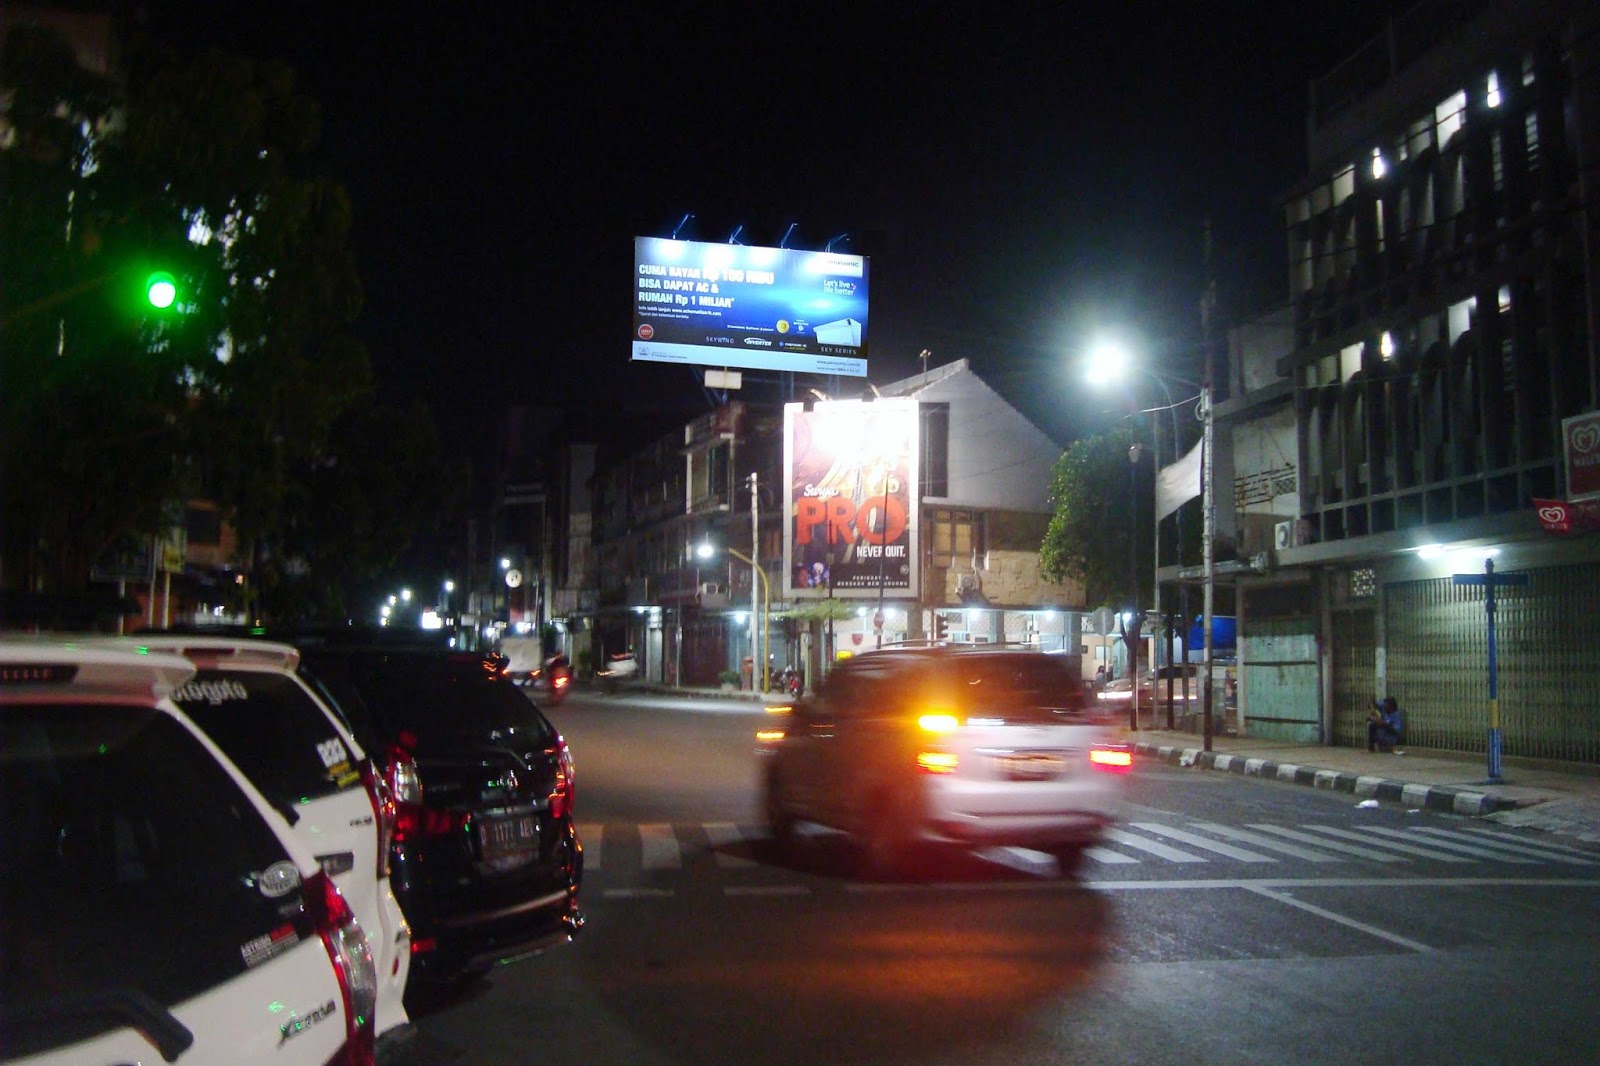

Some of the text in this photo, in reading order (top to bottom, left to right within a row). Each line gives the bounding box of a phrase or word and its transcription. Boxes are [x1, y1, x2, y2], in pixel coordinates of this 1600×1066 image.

[639, 264, 667, 276] CUMA
[639, 278, 661, 289] BISA
[664, 280, 694, 292] DAPAT
[695, 282, 709, 293] AC
[639, 292, 673, 304] RUMAH
[675, 294, 688, 306] Rp
[691, 295, 696, 305] 1
[796, 496, 907, 546] PRO
[885, 545, 906, 558] QUIT.
